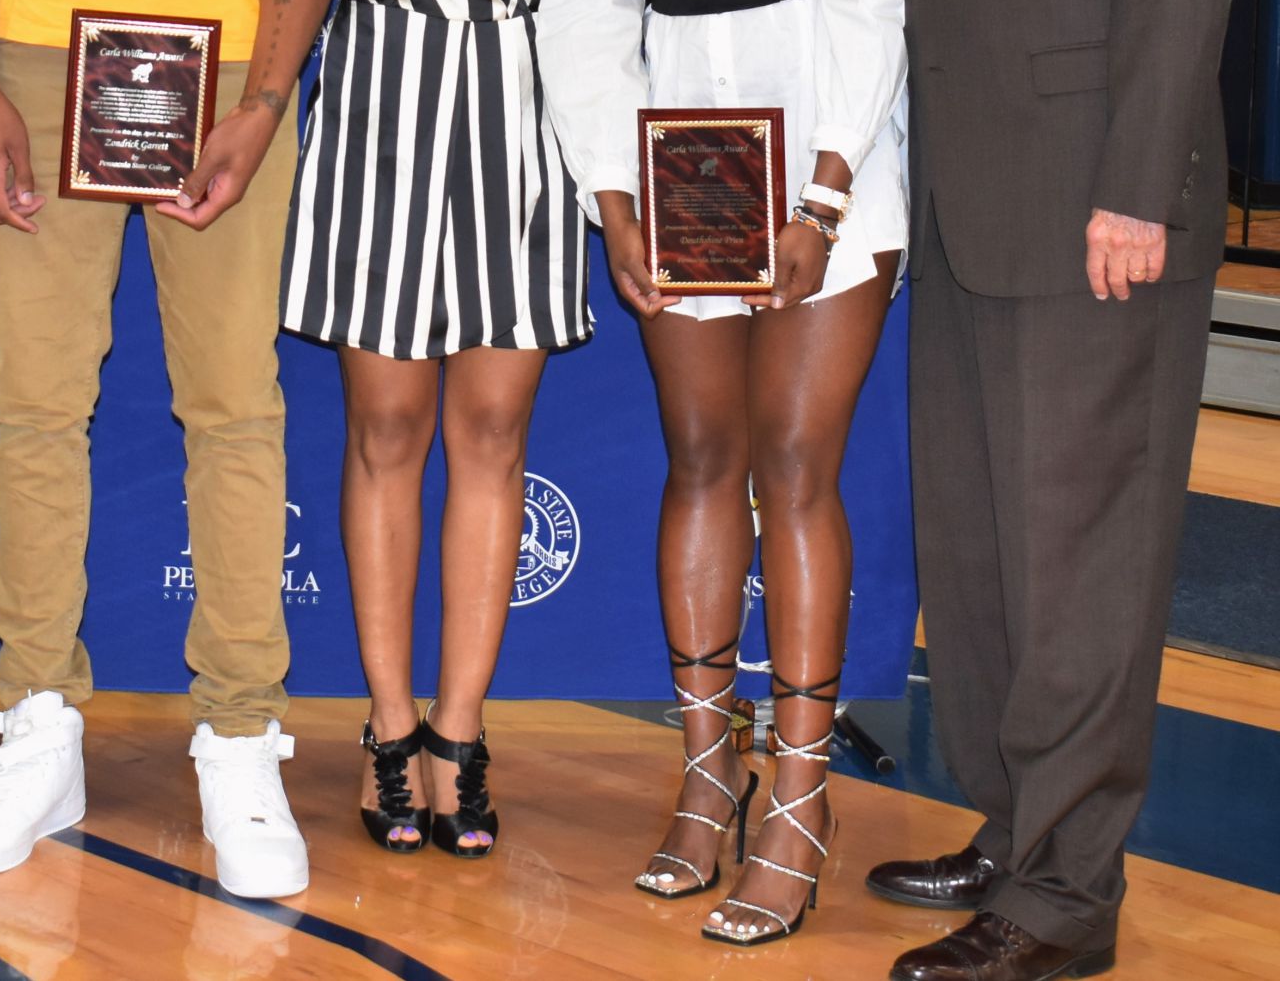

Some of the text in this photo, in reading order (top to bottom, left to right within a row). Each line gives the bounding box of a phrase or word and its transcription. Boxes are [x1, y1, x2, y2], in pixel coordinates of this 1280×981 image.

[100, 47, 121, 56] Carla
[538, 489, 573, 540] STATE
[163, 591, 195, 601] STA
